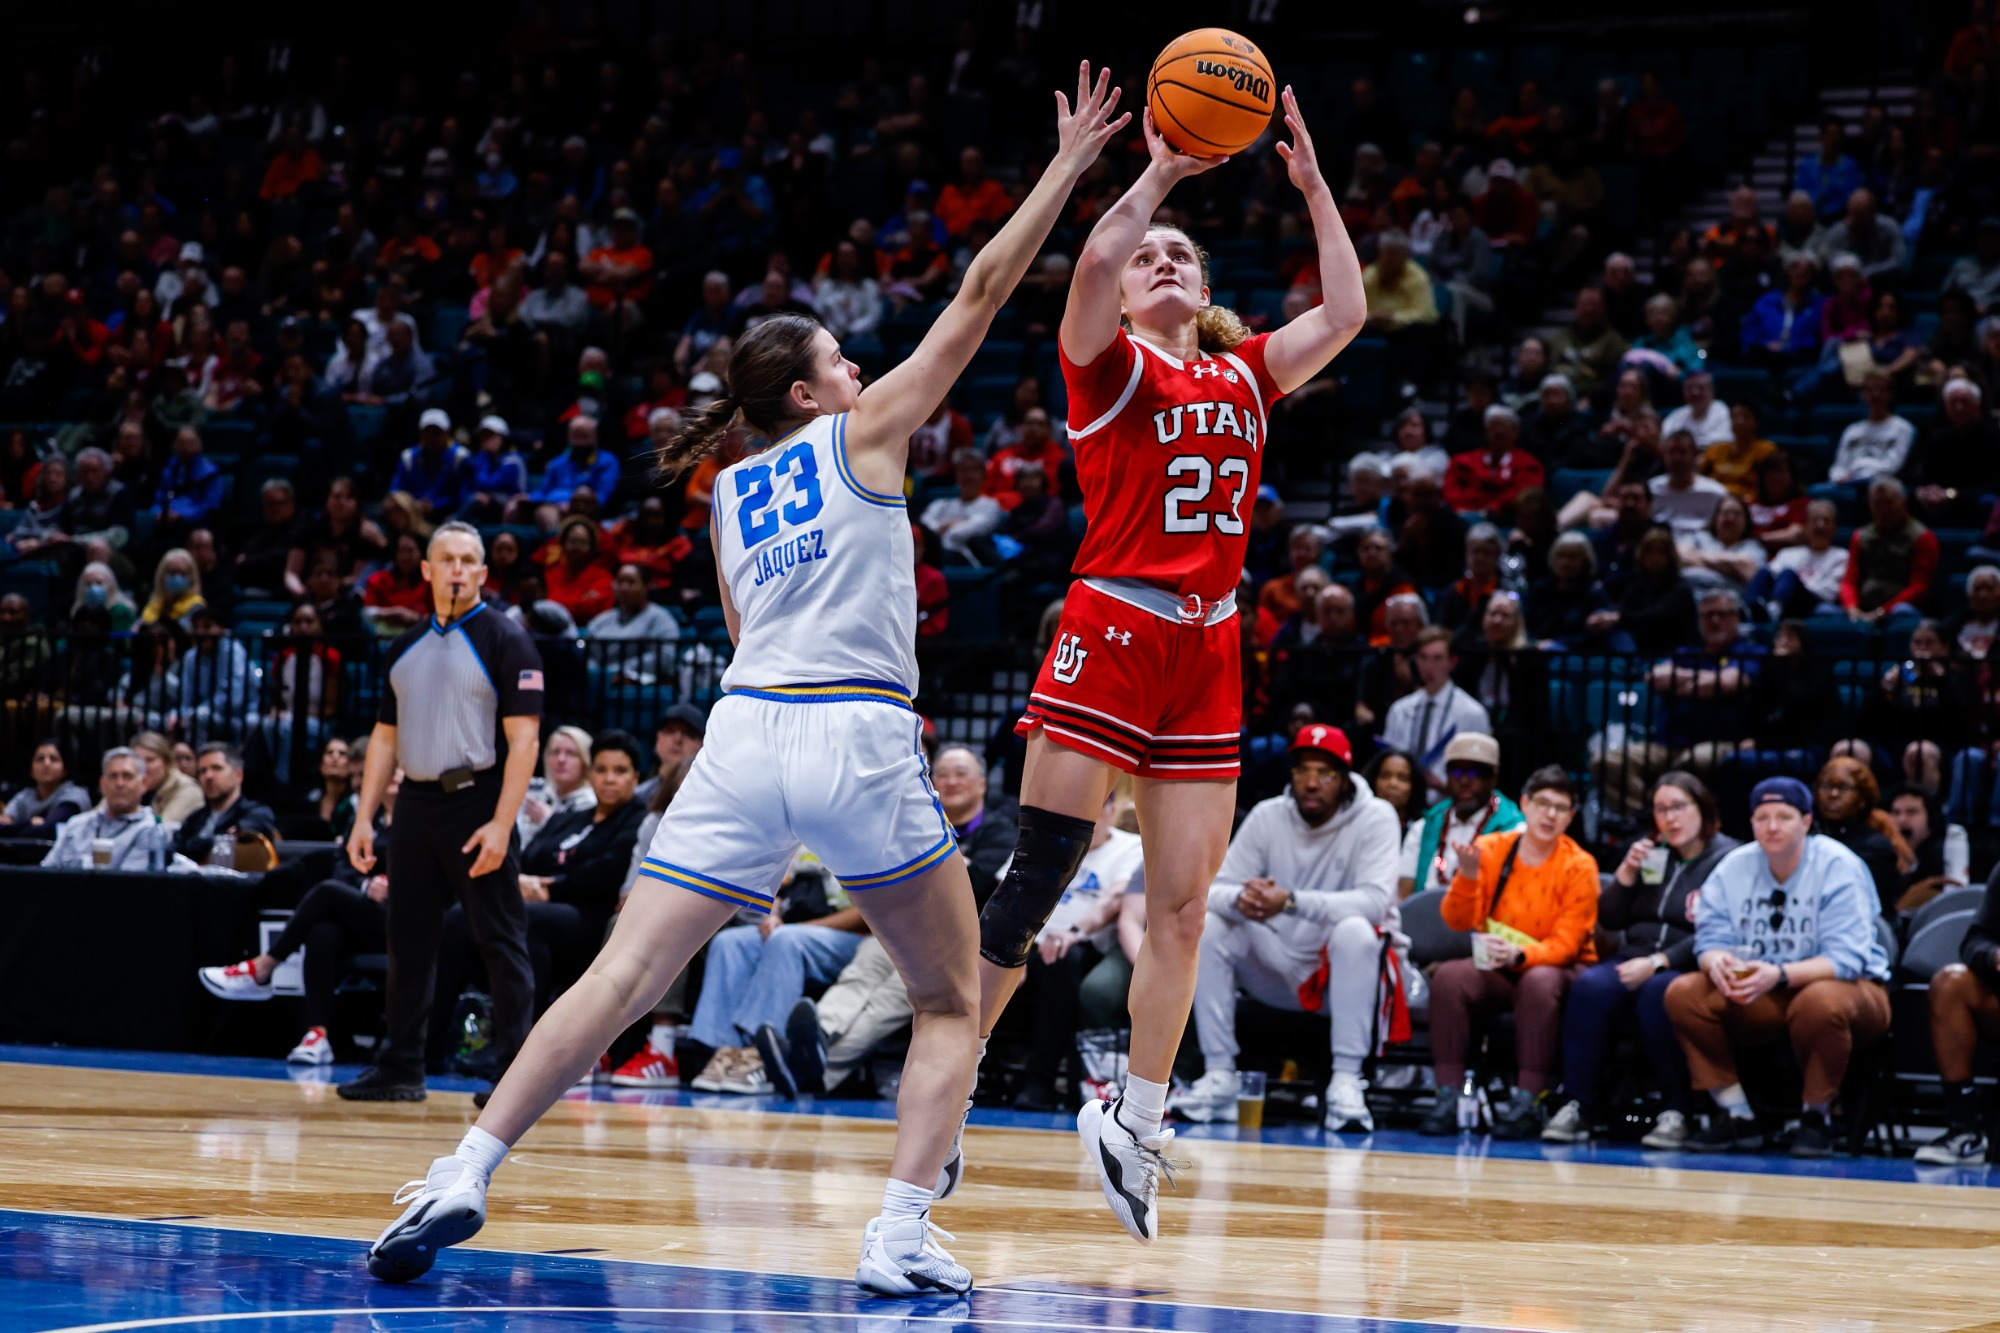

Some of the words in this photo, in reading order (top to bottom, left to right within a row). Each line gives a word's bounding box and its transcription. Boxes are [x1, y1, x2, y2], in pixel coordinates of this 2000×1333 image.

[1196, 60, 1270, 104] Wilson
[1153, 401, 1258, 452] UTAH
[734, 441, 824, 550] 23
[1162, 454, 1249, 536] 23
[754, 528, 828, 587] JAQUEZ
